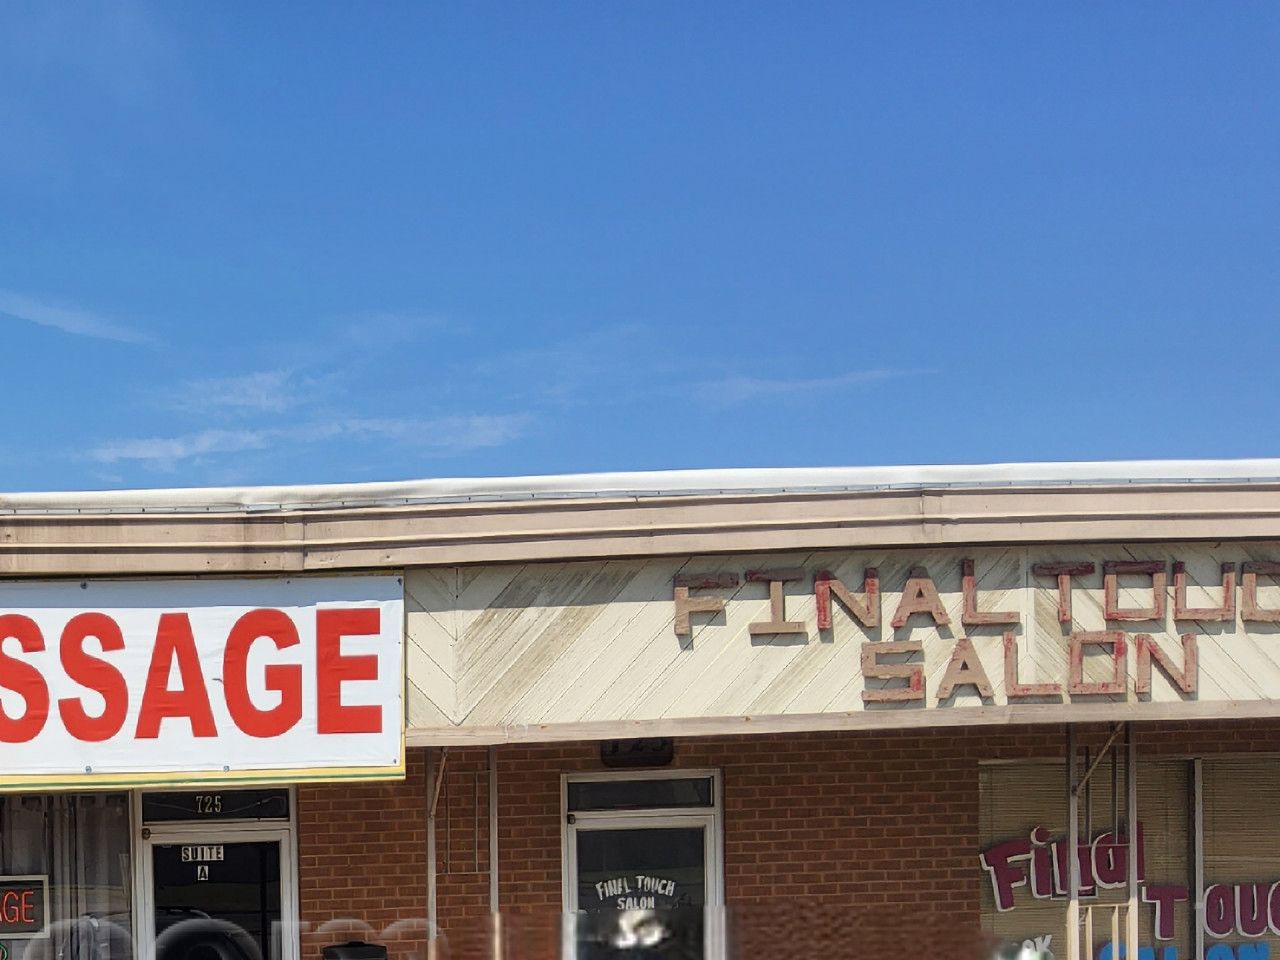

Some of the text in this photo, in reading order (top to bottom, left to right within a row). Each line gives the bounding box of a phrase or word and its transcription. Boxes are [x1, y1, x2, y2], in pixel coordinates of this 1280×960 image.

[673, 558, 1021, 637] FINAL
[861, 630, 1197, 702] SALON
[195, 795, 222, 813] 725
[182, 845, 223, 861] SUITE
[198, 866, 208, 880] A
[635, 875, 676, 897] TOUCH
[616, 896, 655, 910] SALON
